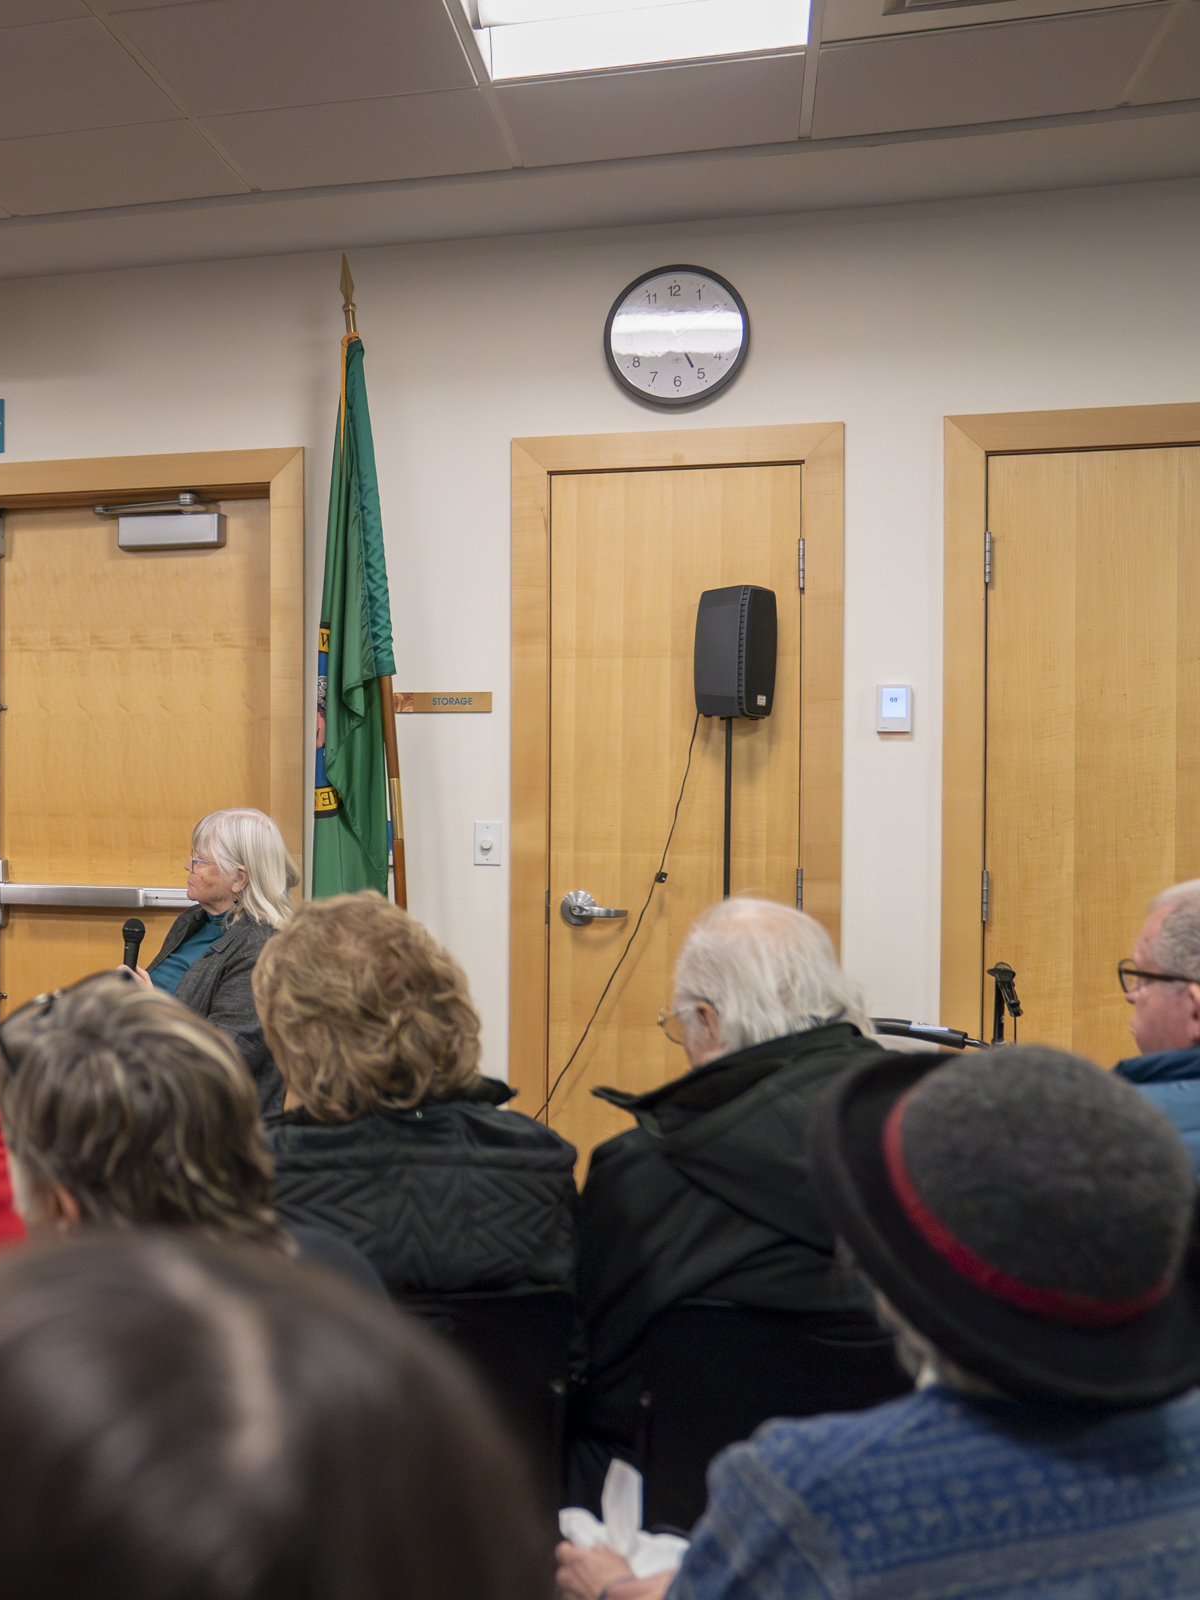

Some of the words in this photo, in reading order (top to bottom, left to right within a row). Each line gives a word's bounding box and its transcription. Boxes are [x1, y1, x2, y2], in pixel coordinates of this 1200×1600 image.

[667, 284, 681, 297] 12
[696, 288, 701, 301] 1
[646, 292, 657, 305] 11
[632, 356, 641, 368] 8
[649, 371, 659, 383] 7
[697, 367, 706, 380] 5
[673, 375, 682, 388] 6
[432, 697, 473, 705] STORAGE
